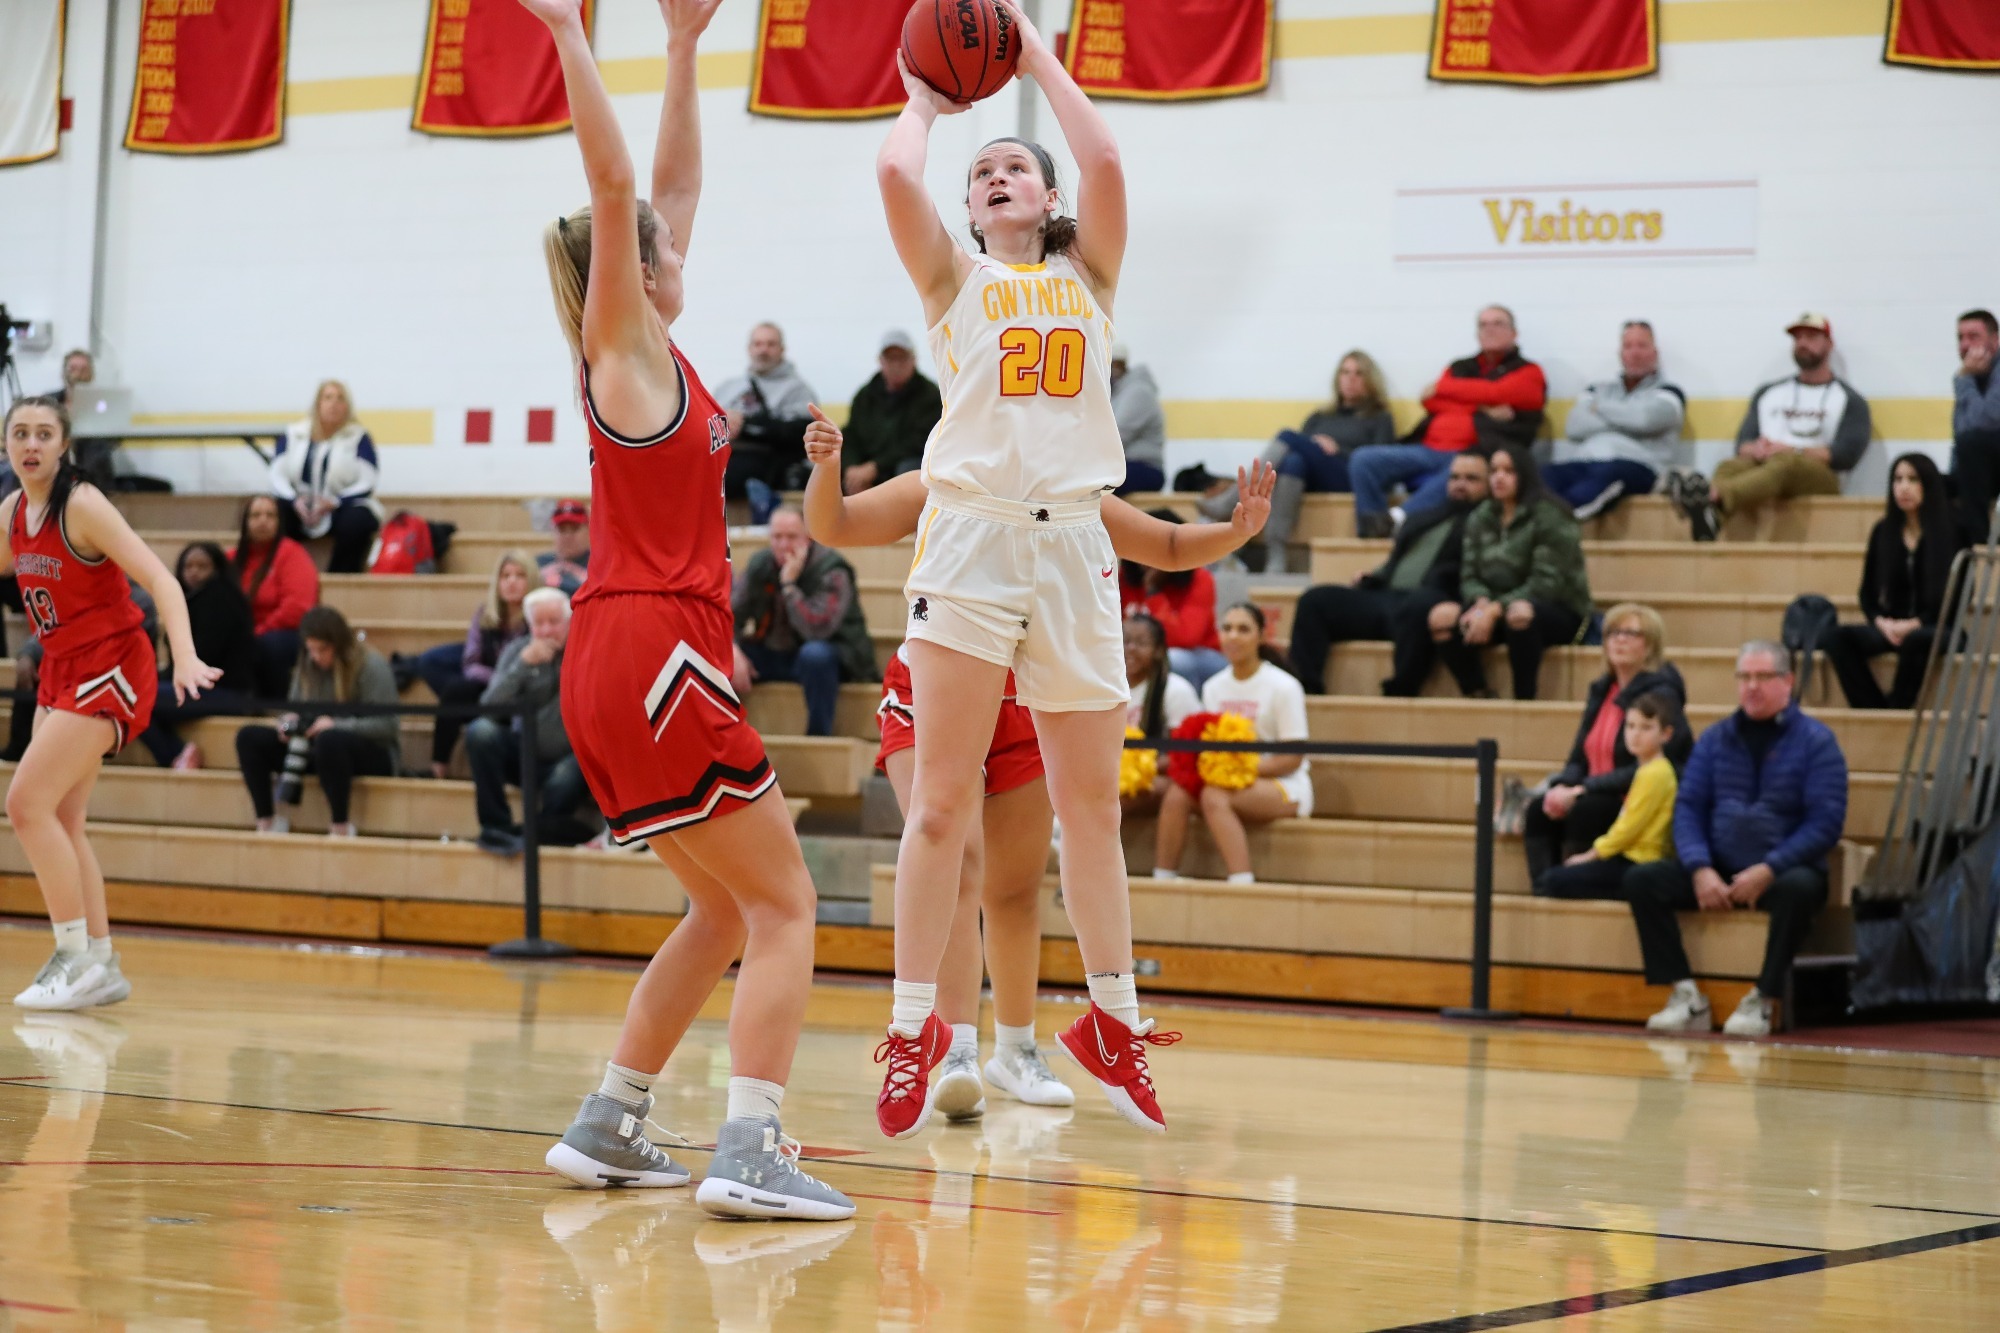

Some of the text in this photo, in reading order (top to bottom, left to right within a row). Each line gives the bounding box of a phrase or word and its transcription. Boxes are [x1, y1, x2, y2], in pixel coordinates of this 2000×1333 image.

[1483, 198, 1663, 244] Visitors
[999, 327, 1086, 398] 20
[23, 586, 59, 638] 13
